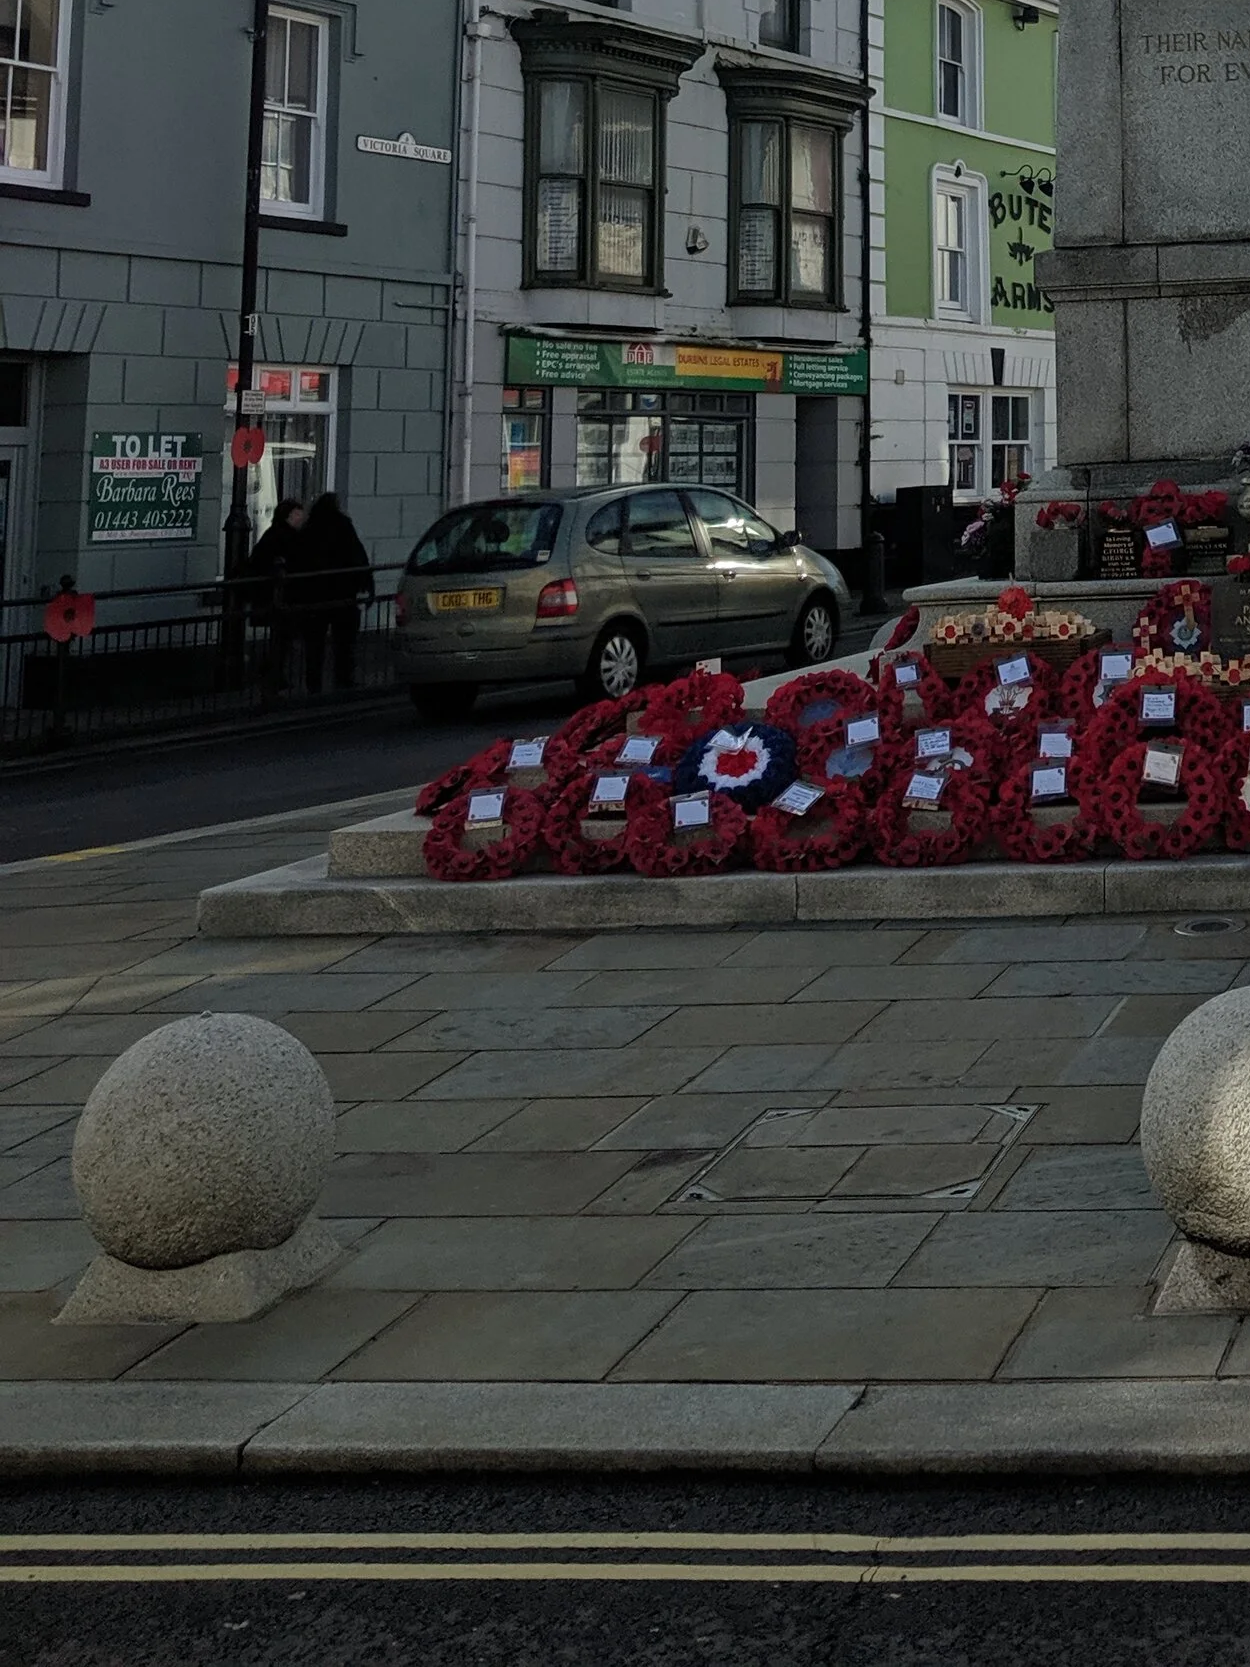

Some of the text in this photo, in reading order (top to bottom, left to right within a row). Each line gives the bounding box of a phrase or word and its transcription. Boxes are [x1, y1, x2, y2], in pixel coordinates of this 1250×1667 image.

[1142, 32, 1208, 54] THEIR
[1160, 64, 1211, 85] FOR
[363, 138, 448, 161] VICTORIA SQUARE
[988, 192, 1052, 234] BUTE
[991, 276, 1055, 313] ARMS
[543, 340, 554, 349] No
[542, 350, 597, 361] Free appraisal
[710, 355, 731, 366] LEGAL
[733, 357, 760, 368] ESTATES
[542, 360, 600, 372] EPC's arranged
[793, 362, 805, 370] Full
[806, 363, 826, 372] letting
[541, 370, 586, 380] Free advice
[793, 371, 863, 383] Conveyancing packages
[793, 379, 848, 389] Mortgage services
[112, 435, 186, 458] TO LET
[111, 459, 130, 470] USER
[132, 459, 146, 470] FOR
[148, 459, 165, 470] SALE
[167, 459, 177, 470] OR
[179, 459, 197, 470] RENT
[97, 474, 195, 507] Barbara Rees
[95, 509, 193, 529] 01443 405222
